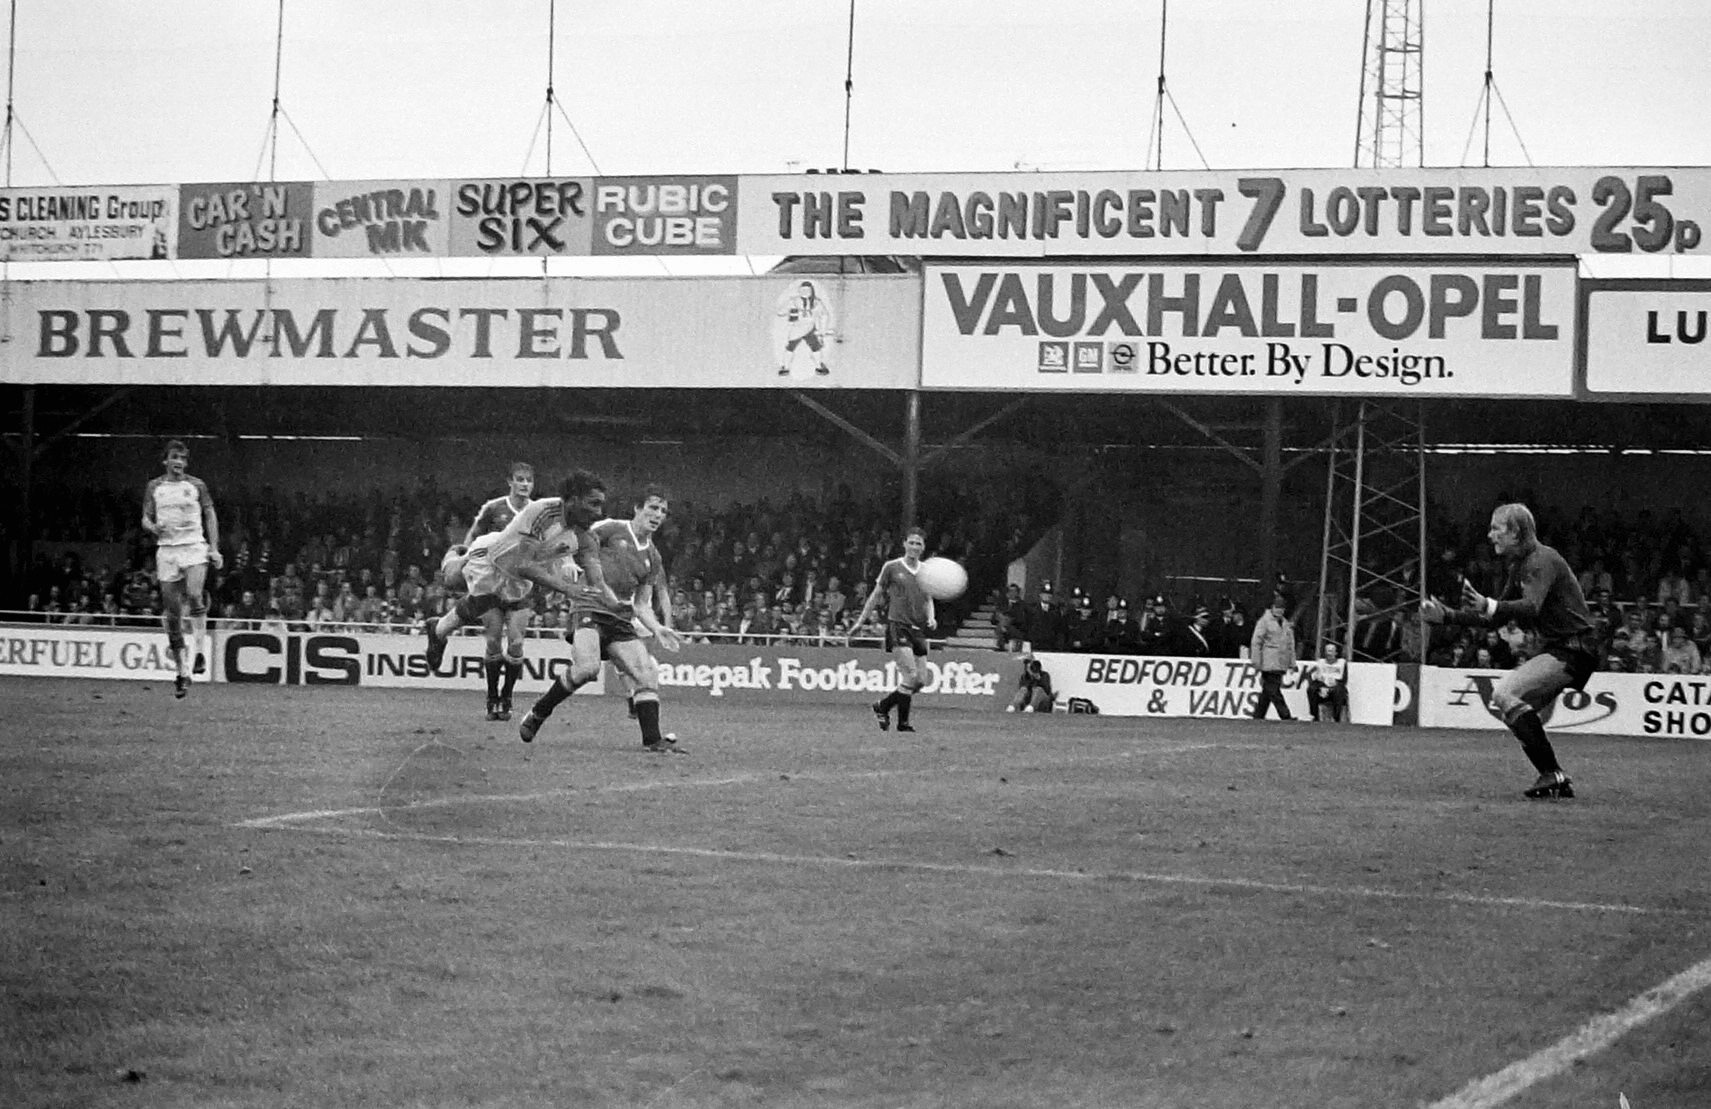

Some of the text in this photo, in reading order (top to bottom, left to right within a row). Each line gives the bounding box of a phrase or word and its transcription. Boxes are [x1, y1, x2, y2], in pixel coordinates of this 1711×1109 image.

[17, 196, 99, 220] CLEANING
[107, 196, 164, 223] Group
[187, 189, 251, 230] CAR
[318, 189, 439, 237] CENTRAL
[456, 182, 584, 217] SUPER
[598, 184, 728, 213] RUBIC
[772, 191, 865, 239] THE
[889, 189, 1225, 240] MAGNIFICENT
[1236, 177, 1286, 252] 7
[1300, 185, 1578, 237] LOTTERIES
[216, 219, 302, 256] CASH
[366, 220, 431, 254] MK
[477, 217, 566, 252] SIX
[605, 217, 724, 247] CUBE
[940, 273, 1559, 340] VAUXHALL-OPEL
[36, 307, 625, 359] BREWMASTER
[1647, 311, 1707, 344] LU
[1146, 342, 1454, 385] Better. By Design.
[224, 634, 361, 685] CIS
[657, 656, 771, 696] anepak
[777, 657, 898, 692] Footbal
[1085, 659, 1211, 688] BEDFORD
[1147, 689, 1168, 714] &
[1644, 681, 1711, 705] CAT
[1644, 710, 1711, 735] SHO
